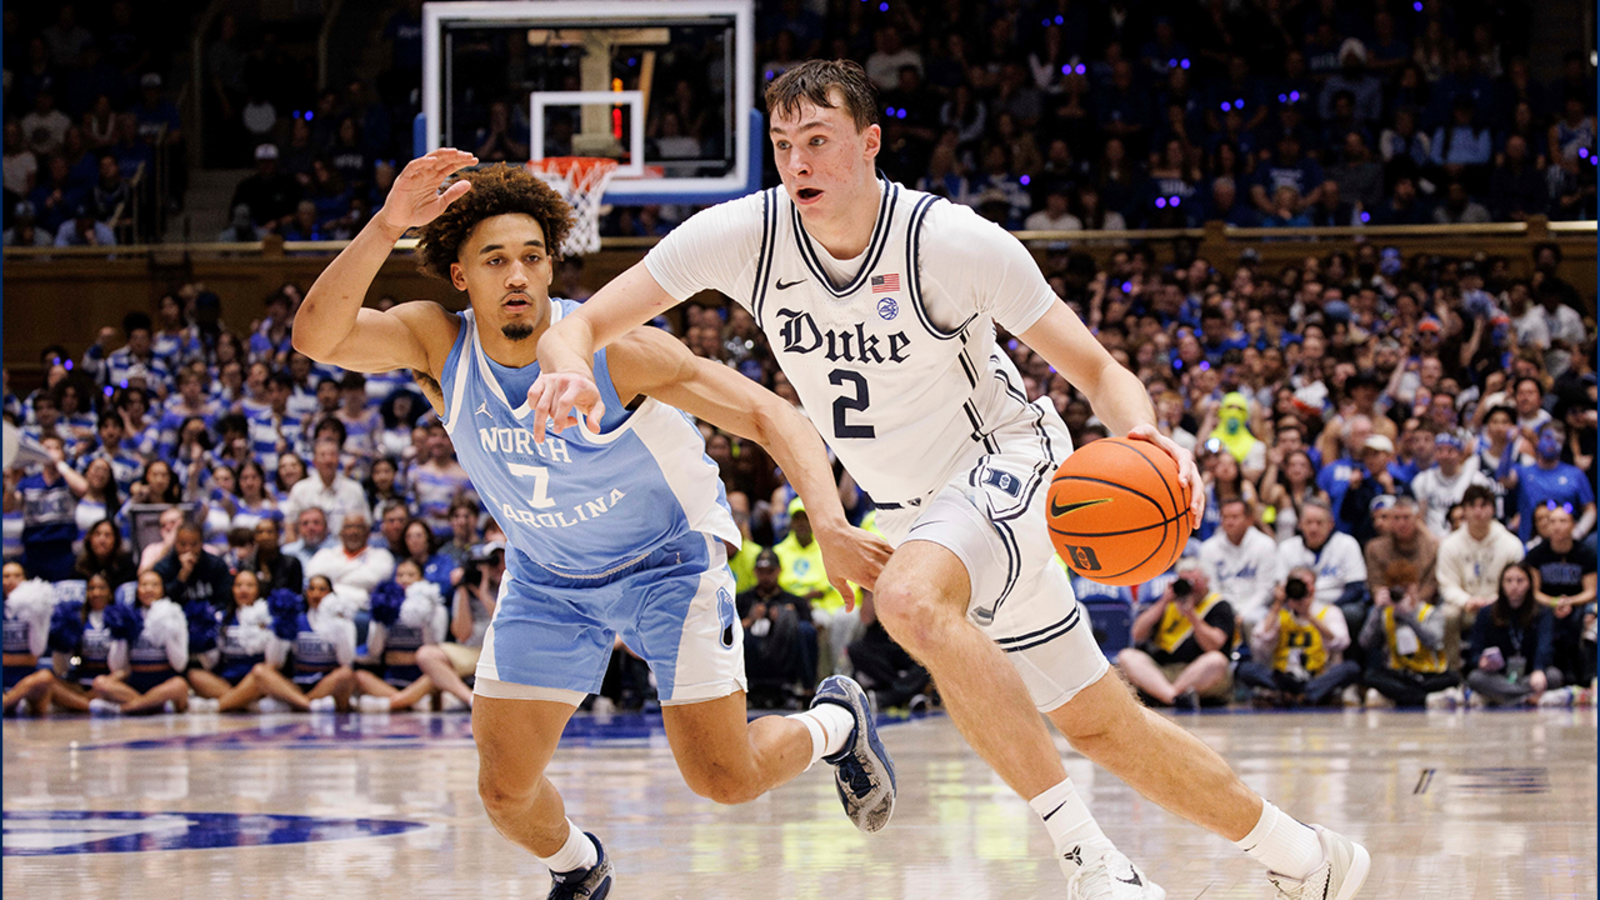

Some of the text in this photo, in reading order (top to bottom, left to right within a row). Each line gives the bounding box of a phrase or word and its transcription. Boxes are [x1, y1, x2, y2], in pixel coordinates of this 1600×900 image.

[776, 307, 911, 364] Duke
[827, 368, 876, 439] 2
[485, 487, 627, 528] AROLINA
[507, 462, 557, 508] 7
